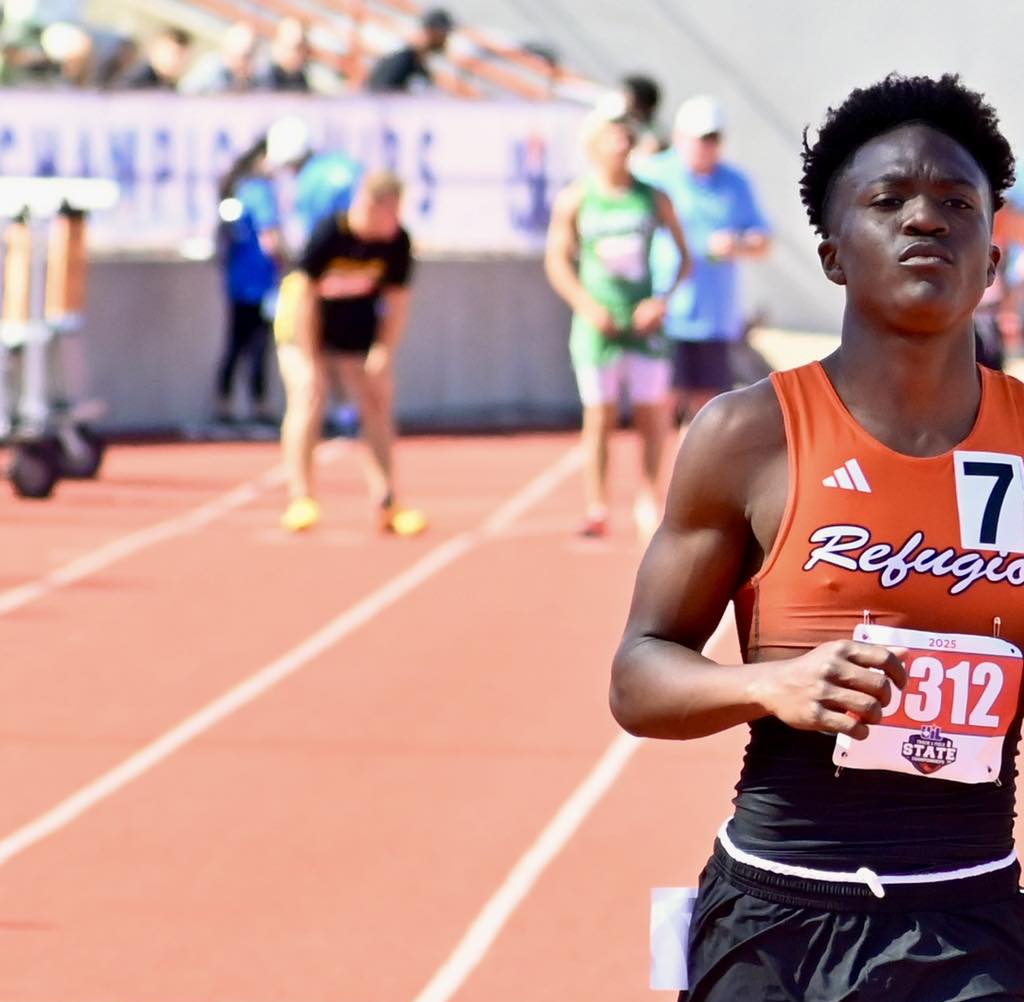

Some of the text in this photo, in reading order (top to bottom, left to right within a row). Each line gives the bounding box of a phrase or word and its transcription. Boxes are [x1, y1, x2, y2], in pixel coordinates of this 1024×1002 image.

[963, 461, 1014, 544] 7
[929, 638, 956, 649] 2025
[902, 743, 956, 762] STATE
